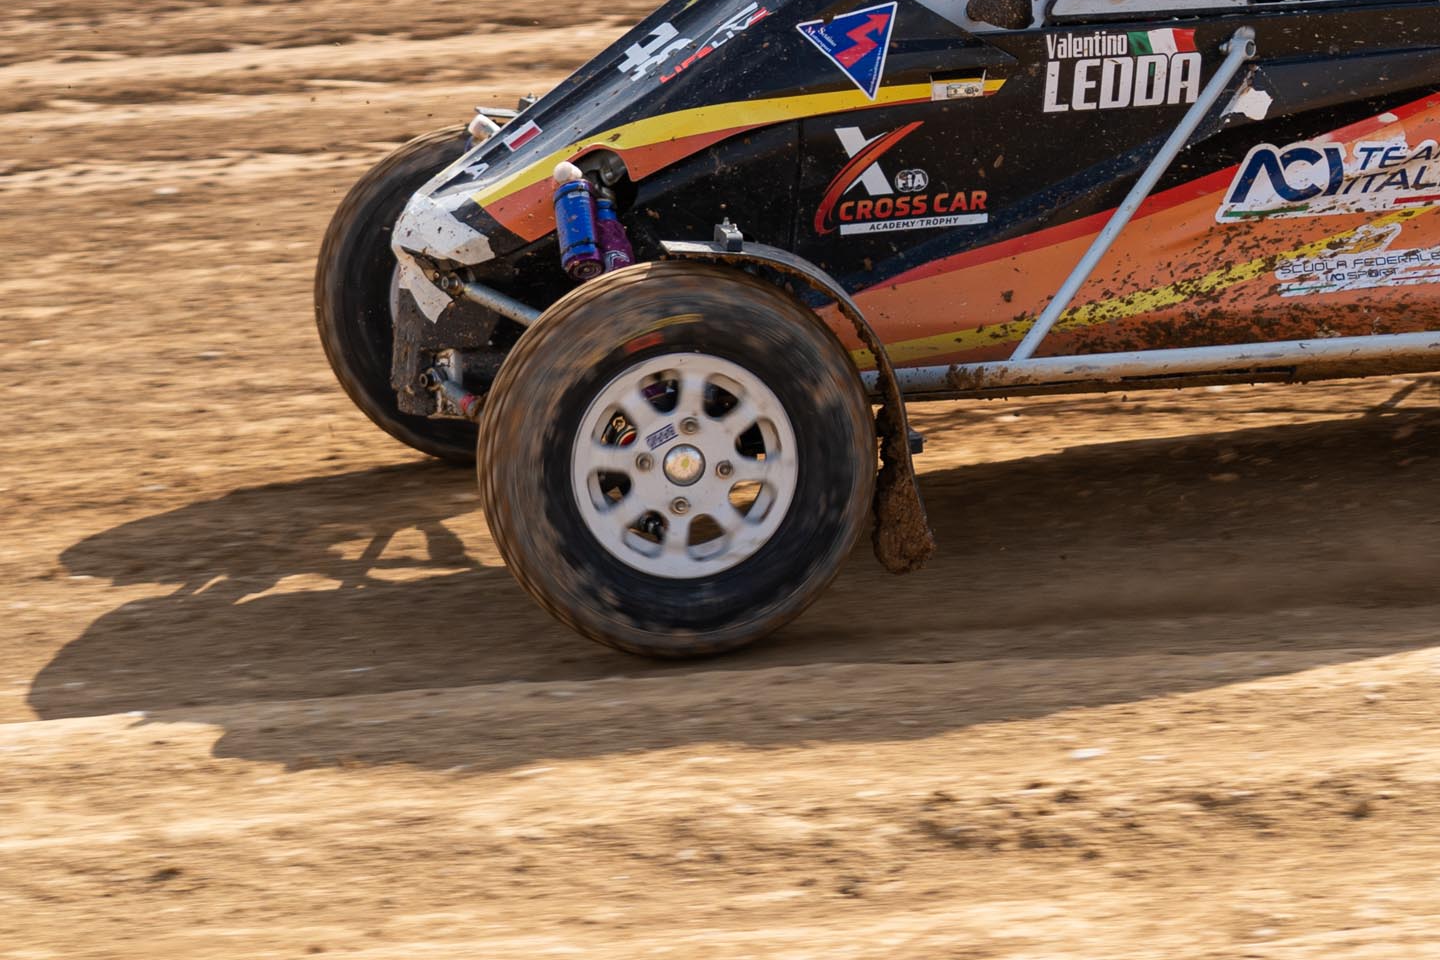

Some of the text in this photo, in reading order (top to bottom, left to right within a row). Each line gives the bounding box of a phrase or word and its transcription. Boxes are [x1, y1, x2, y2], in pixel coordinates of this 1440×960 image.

[1046, 31, 1128, 59] Valentino
[1043, 52, 1202, 113] LEDDA
[1229, 146, 1344, 203] ACI
[839, 190, 988, 221] CROSS CAR
[869, 217, 959, 231] ACADEMY TROPHY
[1280, 260, 1347, 275] SCUOLA
